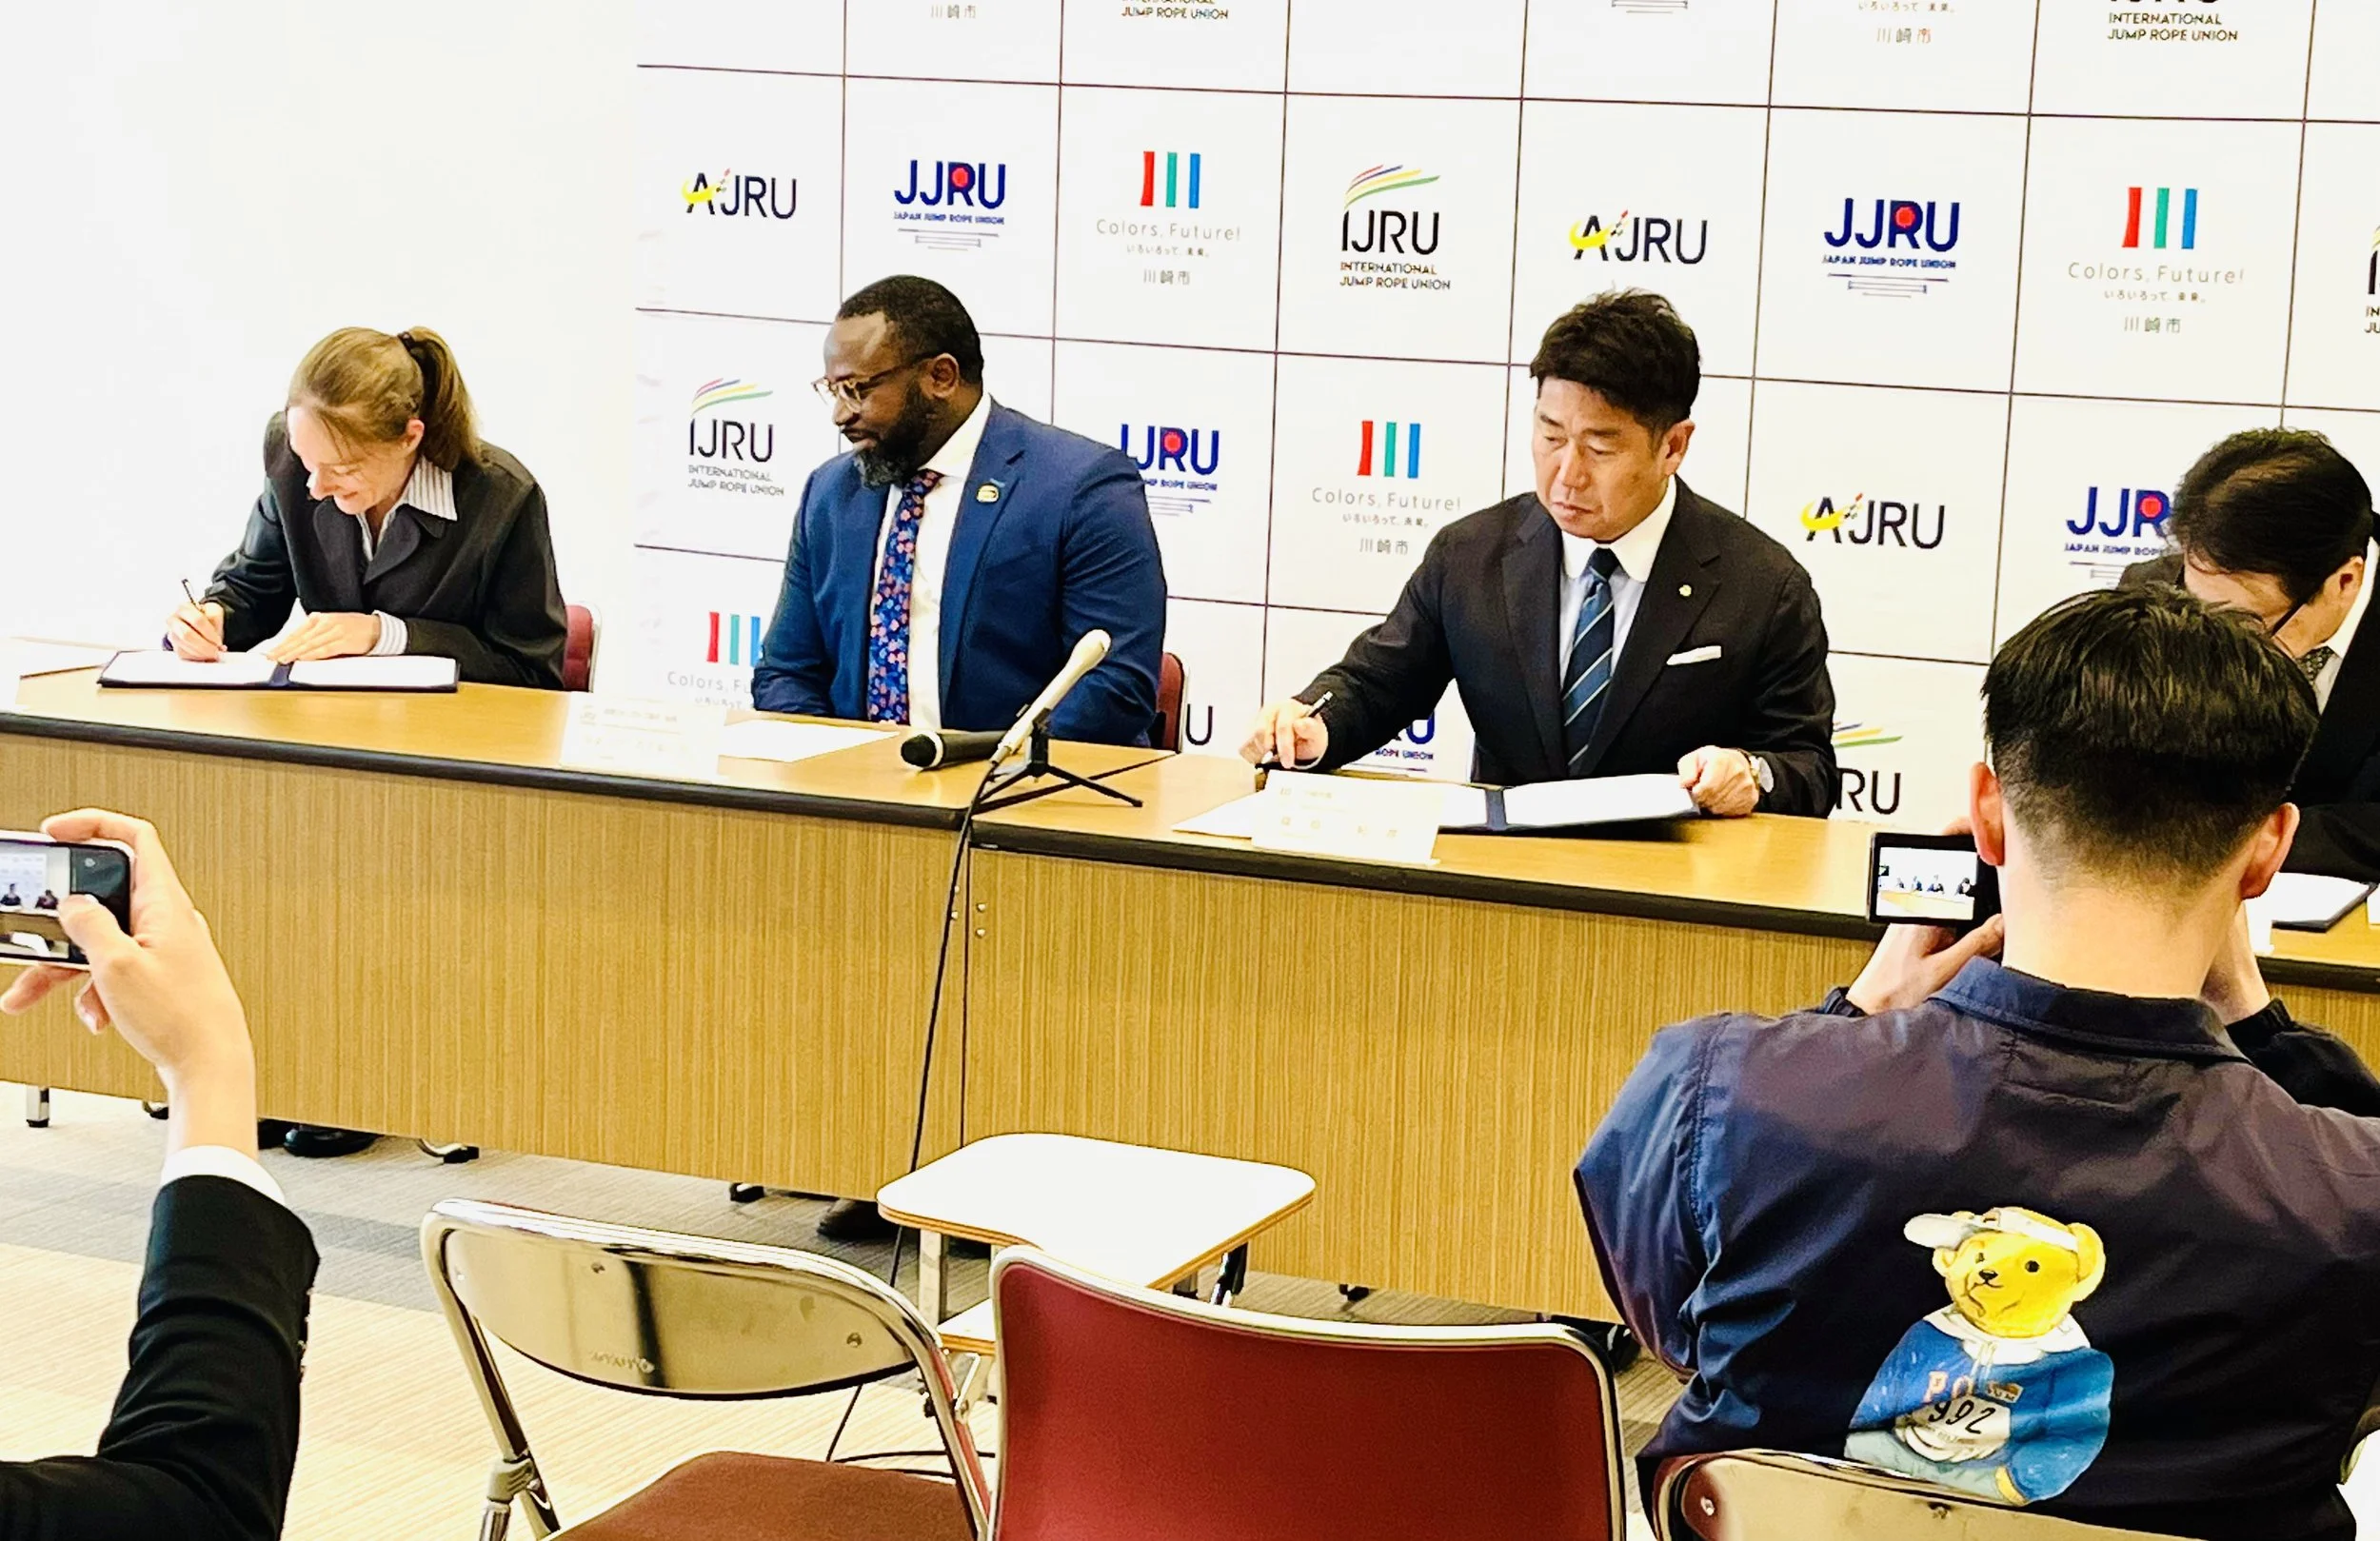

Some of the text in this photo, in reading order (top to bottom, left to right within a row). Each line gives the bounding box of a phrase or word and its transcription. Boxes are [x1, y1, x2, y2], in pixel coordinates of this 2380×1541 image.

[2109, 12, 2222, 25] INTERNATIONAL
[1877, 28, 1931, 44] 川崎市
[2108, 29, 2238, 42] JUMP ROPE UNION
[894, 159, 1006, 209] JJRU
[684, 172, 798, 220] AJRU
[893, 211, 922, 221] JAPAN
[1824, 198, 1960, 252] JJRU
[1170, 223, 1240, 242] Future!
[1341, 209, 1439, 255] IJRU
[1571, 215, 1708, 265] AJRU
[1340, 261, 1438, 275] INTERNATIONAL
[1822, 254, 1856, 265] JAPAN
[1859, 256, 1887, 266] JUMP
[1891, 257, 1917, 267] ROPE
[1143, 268, 1190, 286] 川崎市
[1339, 276, 1451, 290] JUMP ROPE UNION
[2157, 266, 2245, 284] Future!
[2124, 316, 2181, 333] 川崎市
[689, 419, 773, 463] IJRU
[688, 464, 773, 482] INTERNATIONAL
[1387, 491, 1461, 511] Future!
[2066, 486, 2172, 538] JJR
[1803, 497, 1945, 549] AJRU
[1359, 538, 1409, 555] 川崎市
[2065, 543, 2099, 552] JAPAN
